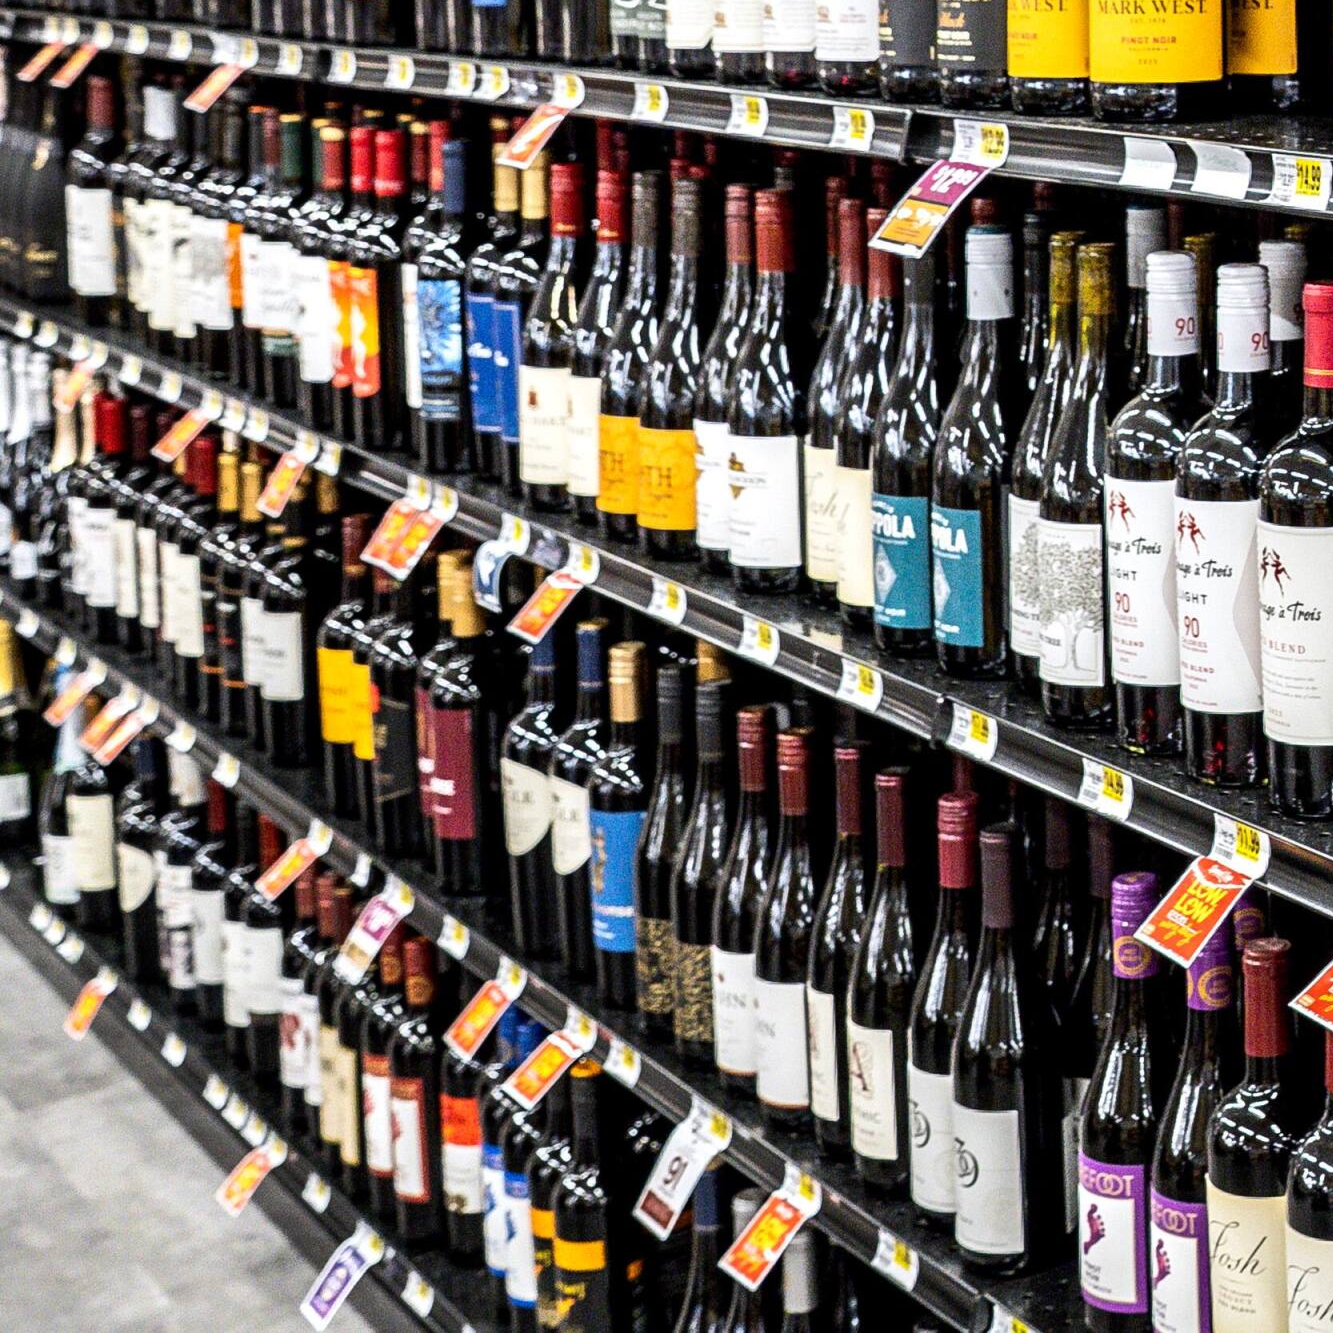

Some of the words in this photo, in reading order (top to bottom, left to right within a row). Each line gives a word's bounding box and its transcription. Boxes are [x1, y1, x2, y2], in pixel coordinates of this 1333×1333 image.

[1120, 35, 1149, 44] PINOT
[1151, 35, 1177, 44] NOIR
[1296, 161, 1321, 196] $14.99
[1182, 615, 1200, 639] 90
